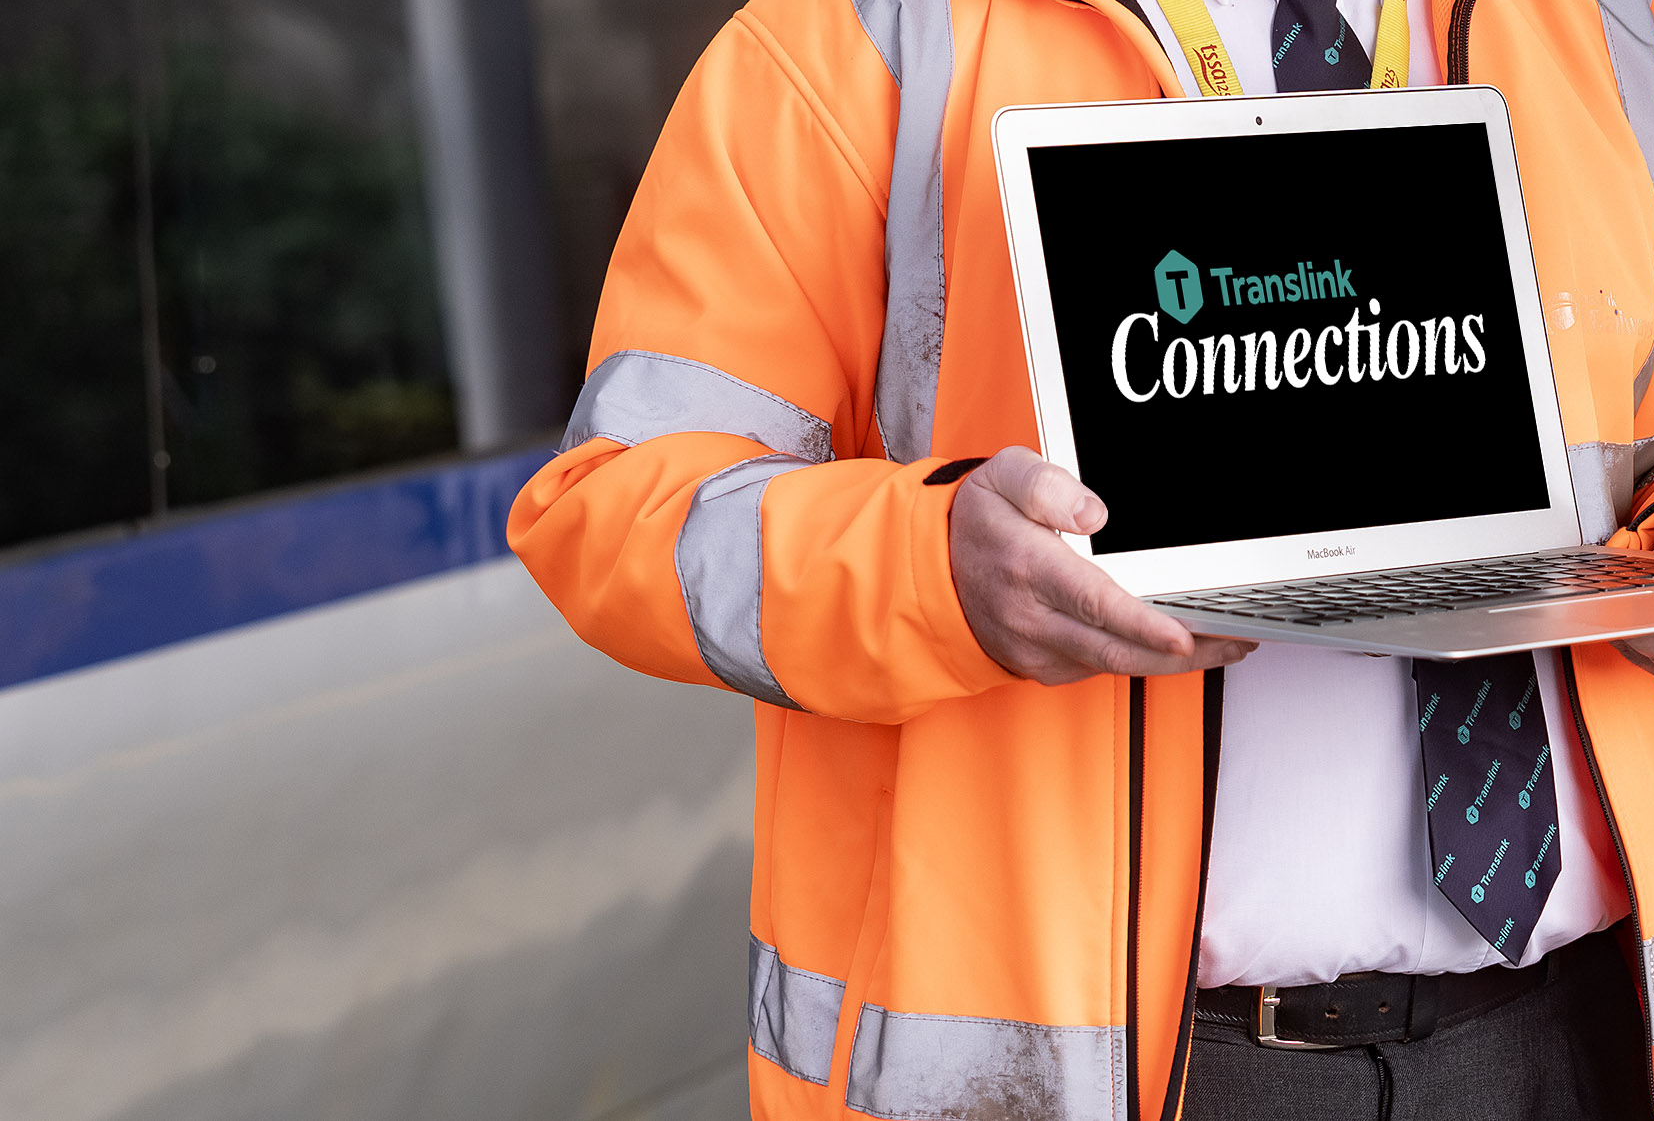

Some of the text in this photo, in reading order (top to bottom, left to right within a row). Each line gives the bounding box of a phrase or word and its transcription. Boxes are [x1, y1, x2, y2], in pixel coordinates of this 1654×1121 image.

[1210, 259, 1357, 307] Translink
[1111, 298, 1486, 403] Connections
[1307, 545, 1356, 559] MacBook Air
[1465, 678, 1492, 727] Translink
[1474, 759, 1501, 808] Translink
[1525, 744, 1550, 792] Translink
[1480, 838, 1510, 887] Translink
[1532, 823, 1557, 872] Translink
